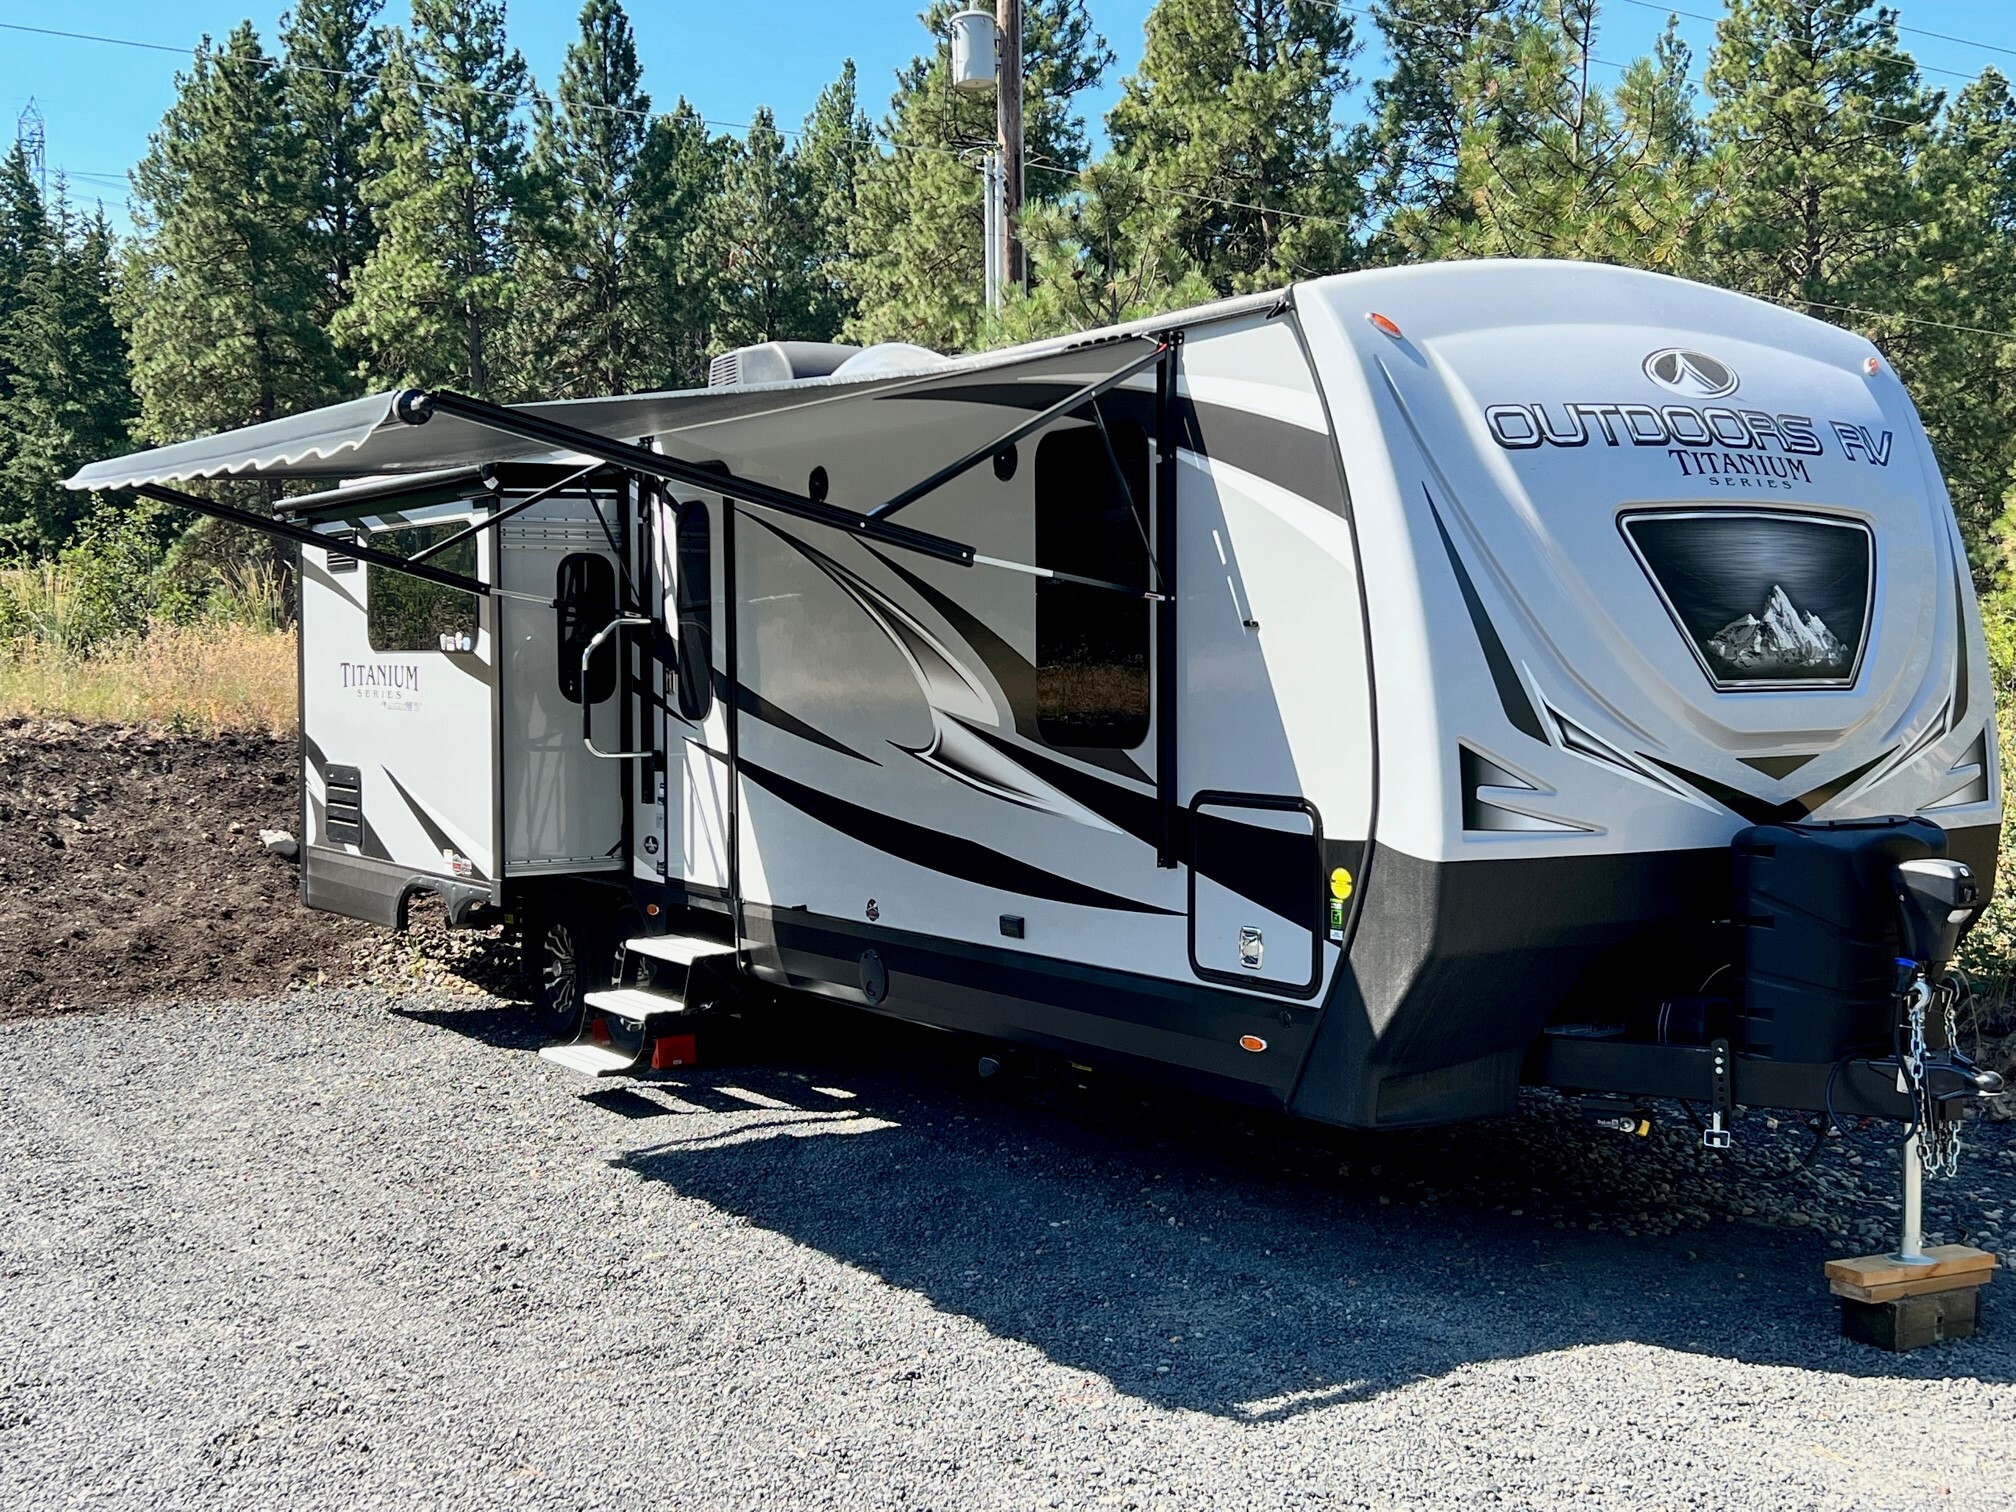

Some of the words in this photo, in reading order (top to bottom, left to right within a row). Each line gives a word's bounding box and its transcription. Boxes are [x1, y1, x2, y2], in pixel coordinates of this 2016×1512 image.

[1485, 404, 1823, 456] OUTDOORS
[1828, 420, 1893, 467] RV
[1708, 476, 1792, 490] SERIES
[357, 688, 402, 700] SERIES
